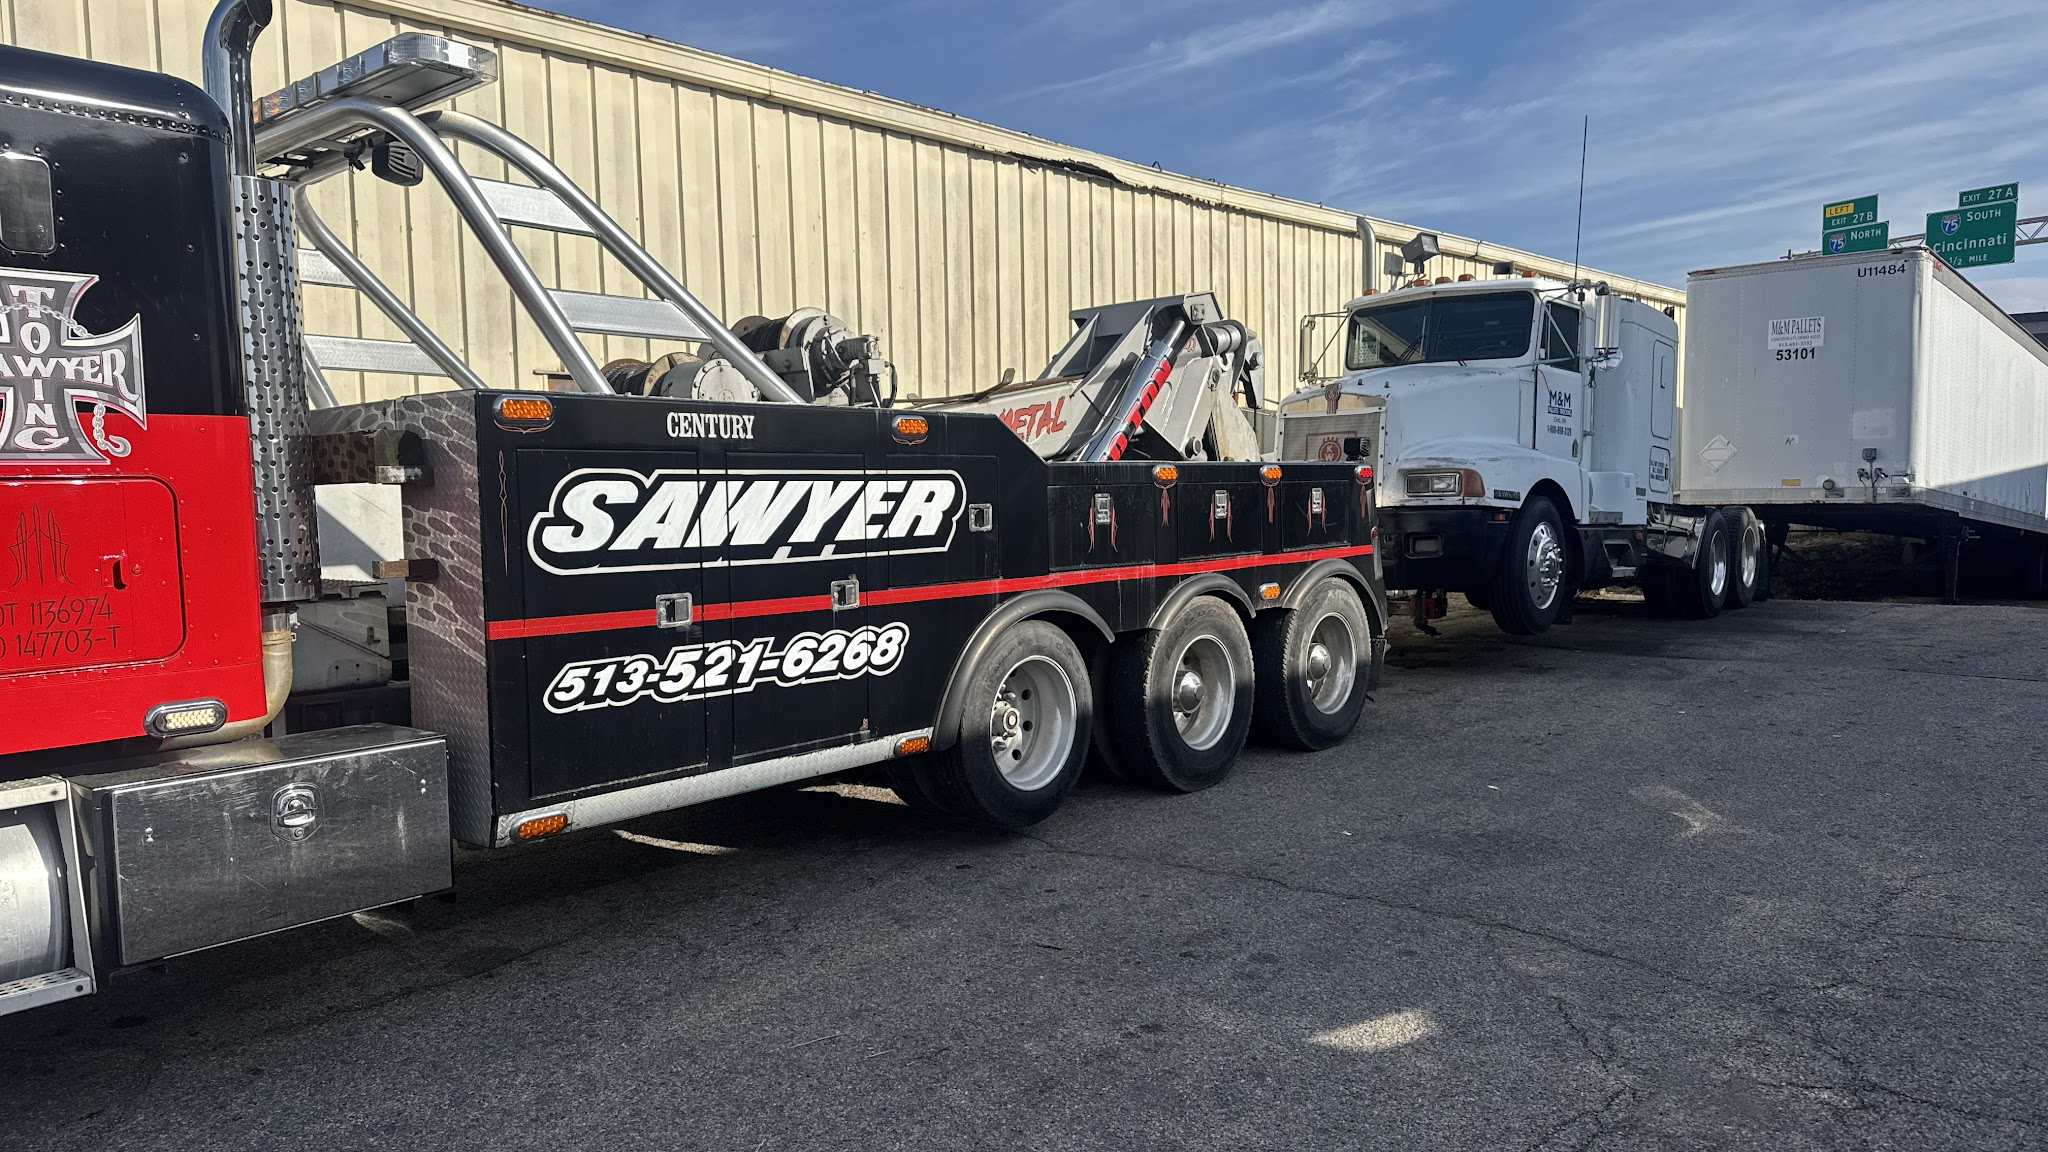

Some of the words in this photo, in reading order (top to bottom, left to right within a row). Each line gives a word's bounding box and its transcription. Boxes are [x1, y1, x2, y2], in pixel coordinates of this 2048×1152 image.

[1963, 193, 1981, 203] EXIT
[1988, 189, 2003, 200] 27
[2005, 187, 2014, 198] A
[1829, 205, 1850, 216] LEFT
[1966, 209, 2002, 221] SOUTH
[1831, 217, 1847, 226] EXIT
[1852, 213, 1865, 223] 27
[1867, 211, 1874, 221] B
[1943, 219, 1959, 232] 75
[1850, 228, 1882, 241] NORTH
[1831, 238, 1844, 250] 75
[1933, 233, 2007, 253] Cincinnati
[1949, 256, 1963, 266] 1/2
[1968, 254, 1988, 263] MILE
[1857, 263, 1906, 278] U11484
[1771, 320, 1791, 335] M&M
[1791, 317, 1822, 334] PALLETS
[1776, 347, 1815, 361] 53101
[1549, 390, 1571, 408] M&M
[666, 411, 755, 440] CENTURY
[541, 479, 957, 555] SAWYER
[29, 593, 113, 629] 1136974
[15, 626, 121, 659] 147703-T
[552, 628, 904, 704] 513-521-6268
